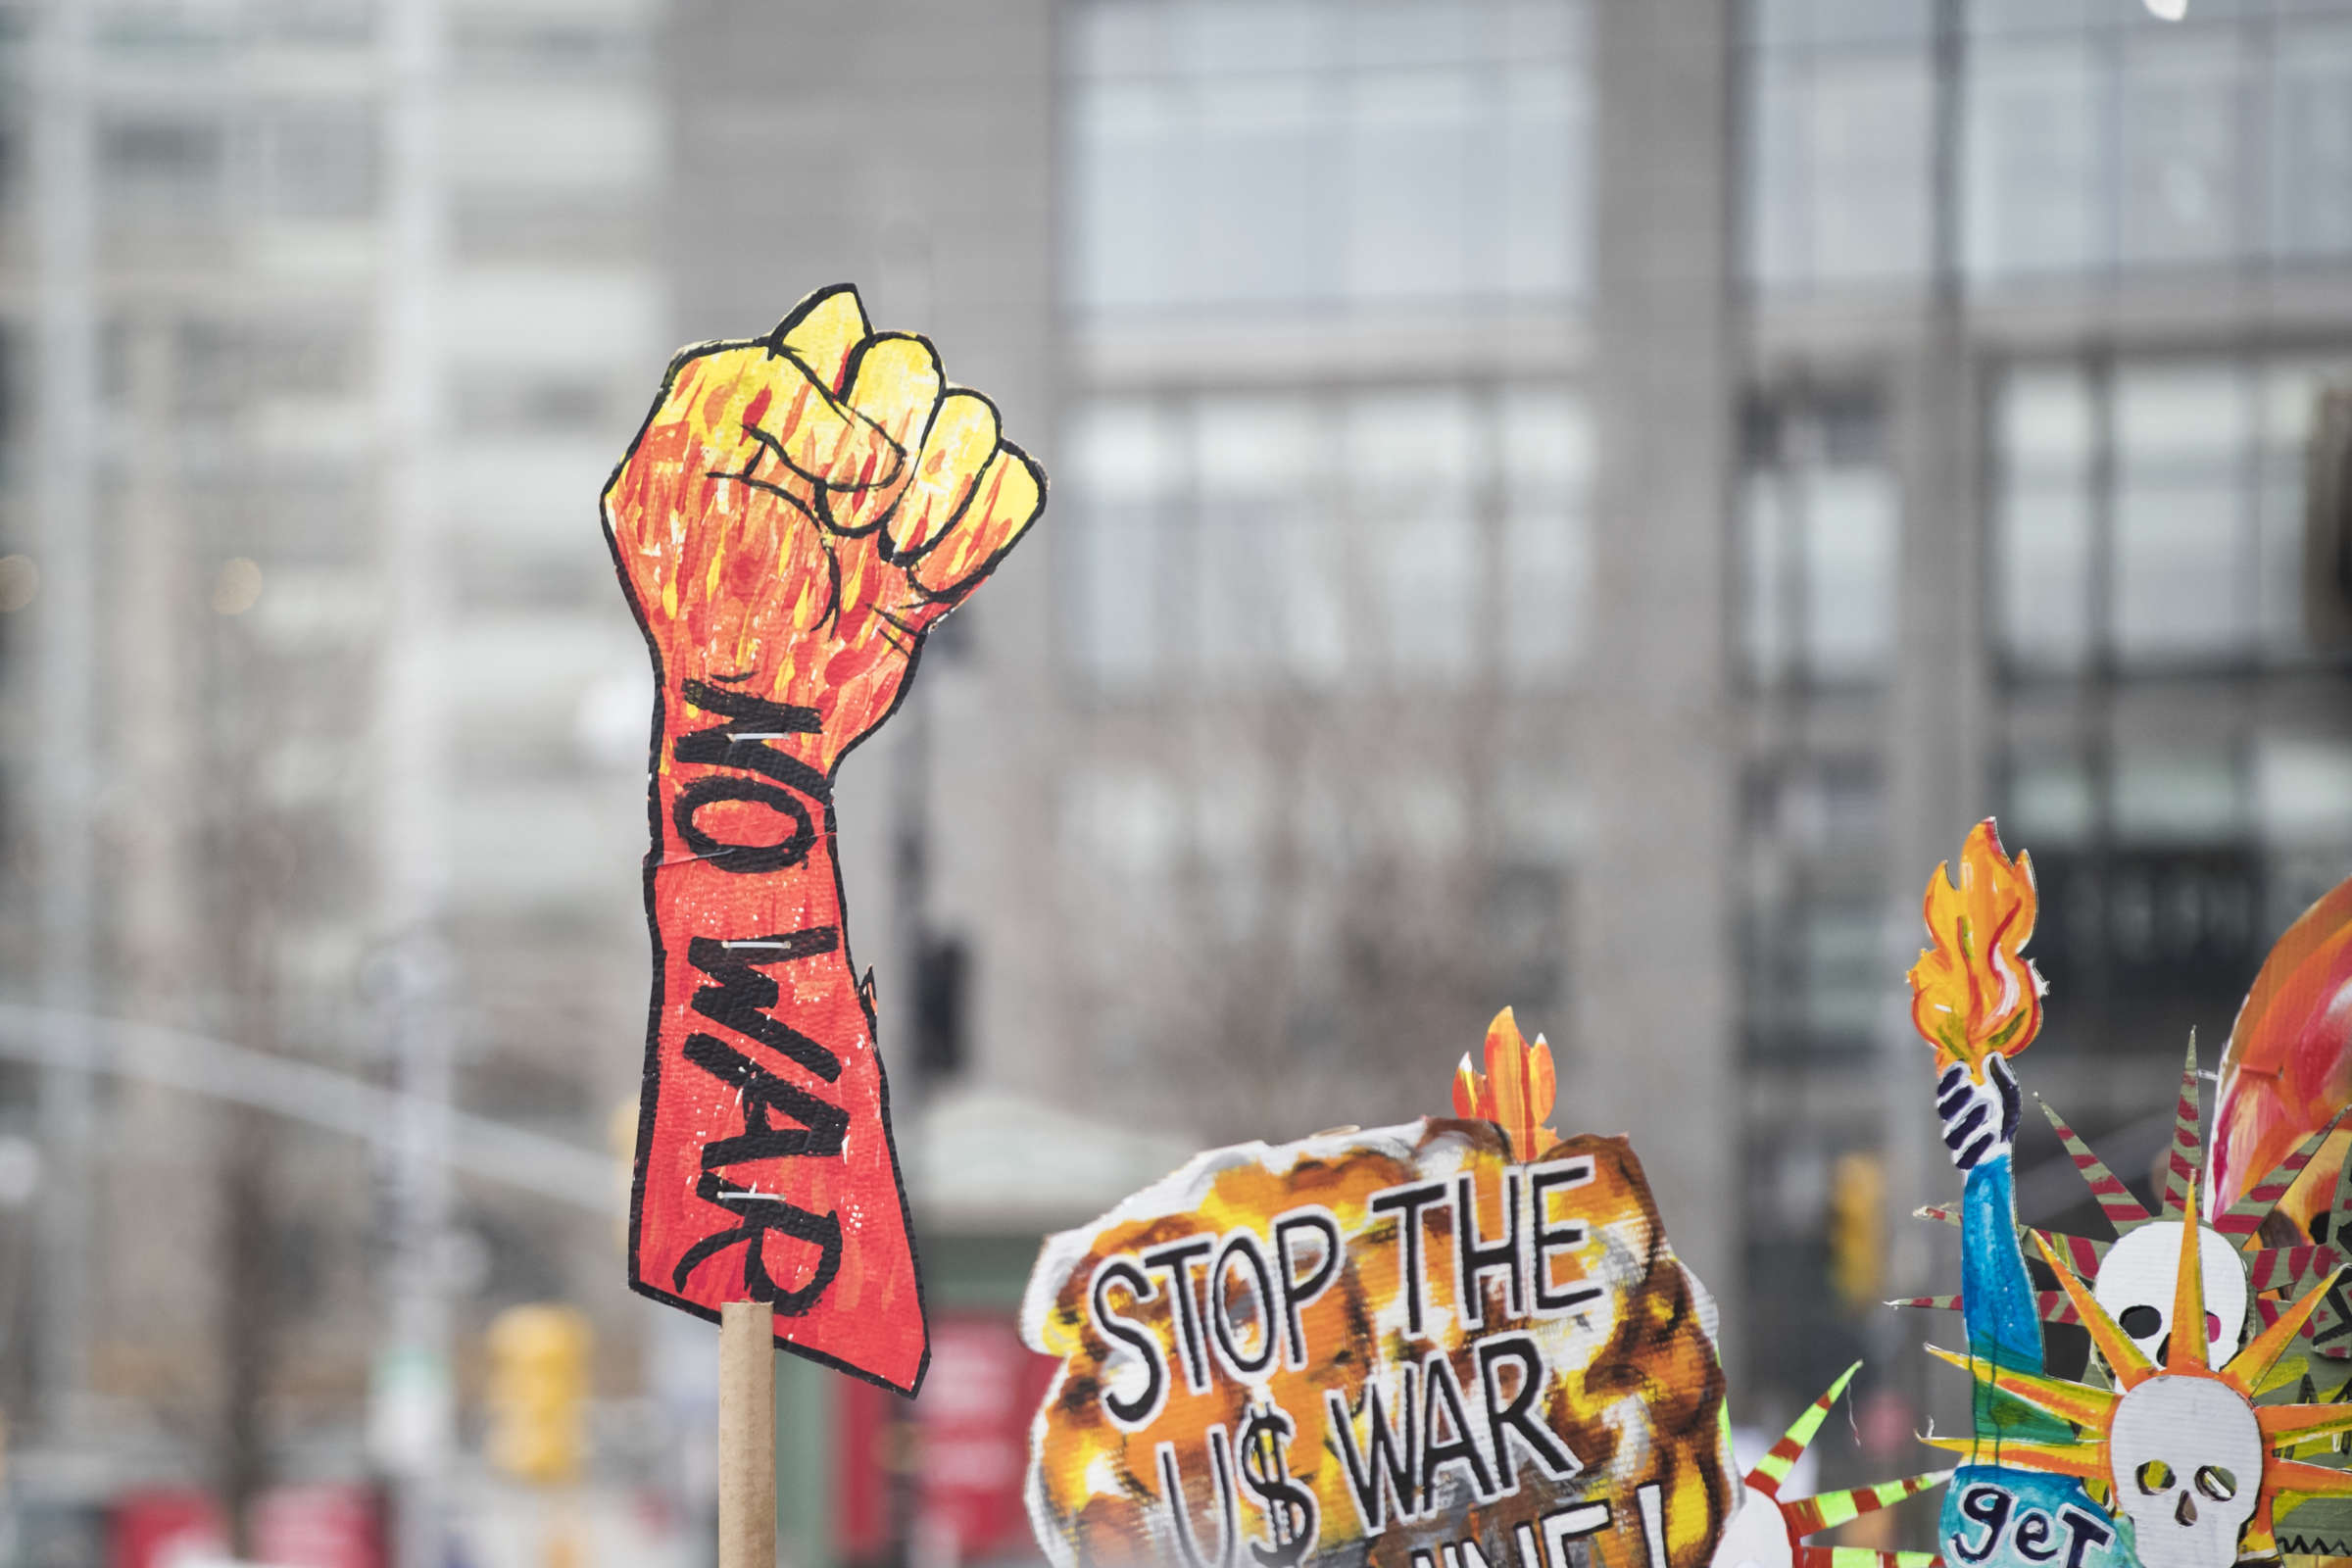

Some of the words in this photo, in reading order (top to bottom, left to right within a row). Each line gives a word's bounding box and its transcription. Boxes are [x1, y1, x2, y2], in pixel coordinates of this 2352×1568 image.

[672, 676, 836, 874] NO
[672, 925, 851, 1318] WAR
[1091, 1212, 1341, 1424] STOP
[1371, 1162, 1603, 1336] THE
[1161, 1399, 1317, 1568] U$
[1330, 1337, 1583, 1529] WAR
